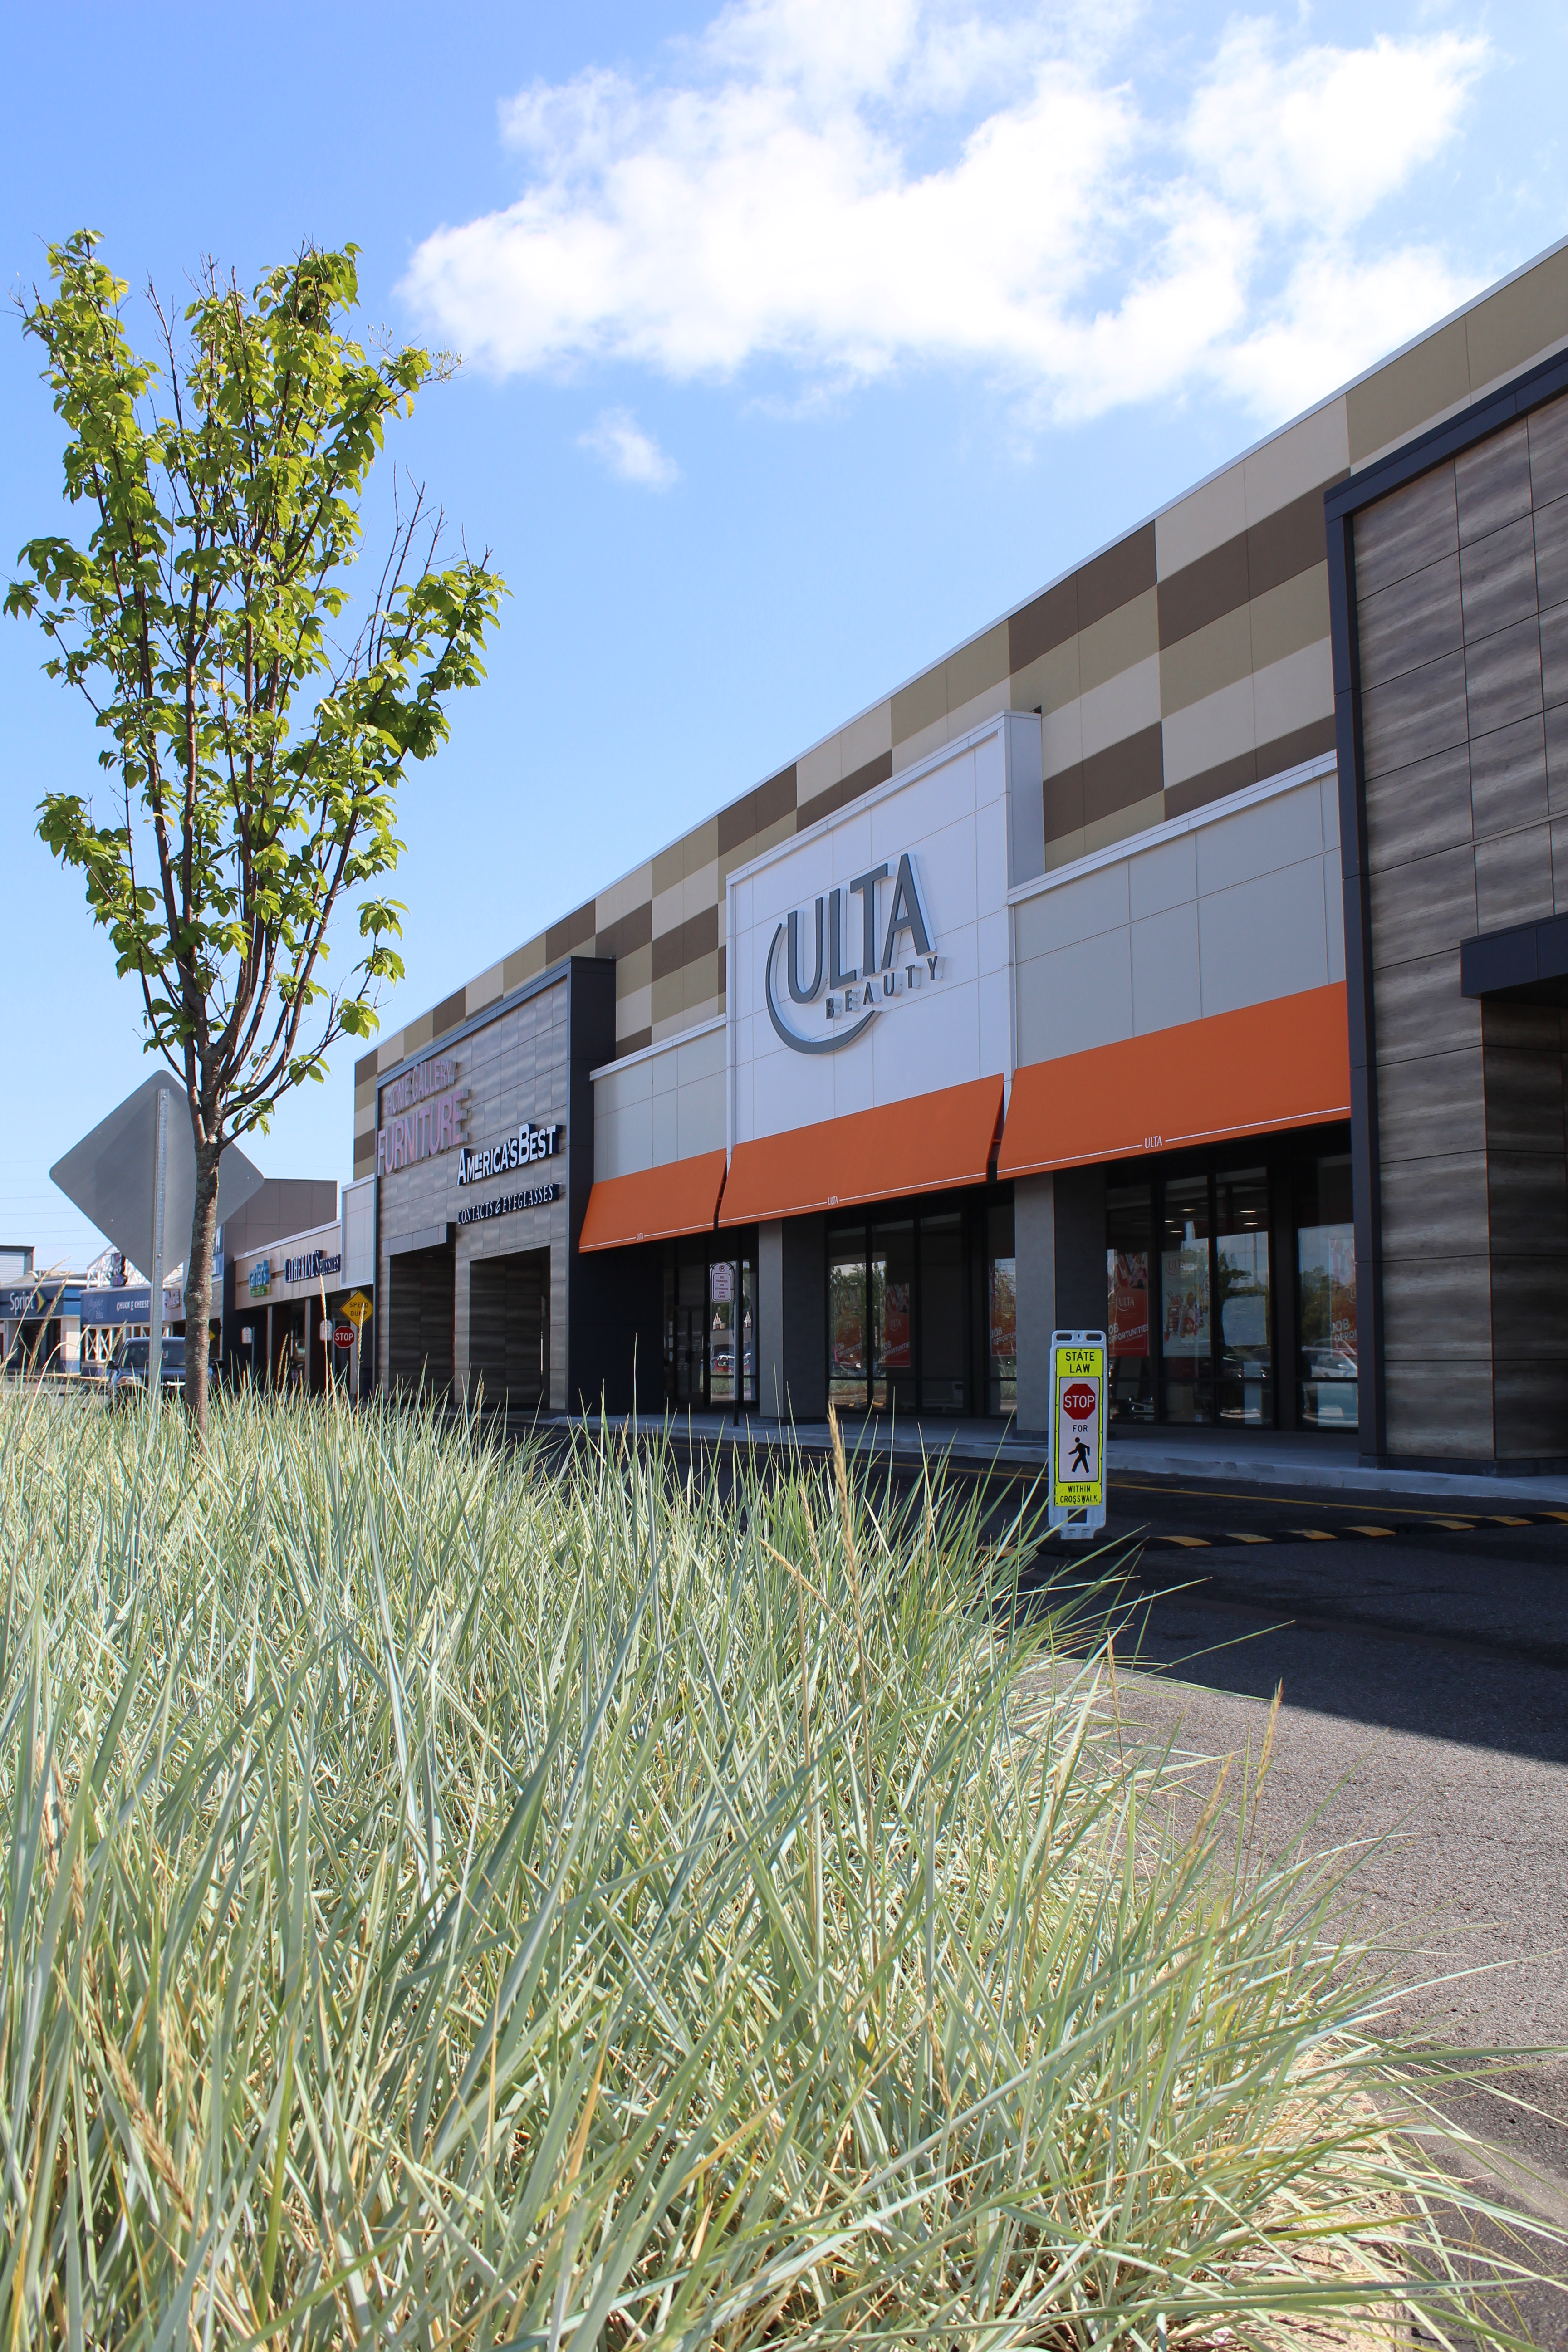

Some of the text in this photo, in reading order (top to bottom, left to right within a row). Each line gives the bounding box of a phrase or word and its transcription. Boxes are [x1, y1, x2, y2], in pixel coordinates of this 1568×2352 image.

[787, 853, 936, 1004] ULTA
[825, 956, 944, 1020] BEAUTY
[387, 1060, 455, 1116] HOME GALLERY
[377, 1089, 468, 1176] FURNITURE
[1145, 1135, 1162, 1149] ULTA
[457, 1123, 558, 1186] AMERICA'S BEST
[457, 1201, 493, 1225] CONTACTS
[502, 1183, 554, 1212] EYEGLASSES
[828, 1196, 838, 1205] ULTA
[10, 1291, 34, 1316] Sprint
[116, 1301, 130, 1312] CHUCK
[130, 1301, 134, 1311] E
[1118, 1297, 1135, 1306] ULTA
[991, 1326, 1002, 1338] JOB
[1108, 1323, 1119, 1335] OB
[1331, 1318, 1350, 1334] JOB
[335, 1333, 353, 1341] STOP
[1334, 1329, 1357, 1343] OPPO
[836, 1342, 844, 1352] JOB
[881, 1340, 891, 1352] JOB
[1065, 1352, 1095, 1361] STATE
[1069, 1364, 1090, 1373] LAW
[1064, 1395, 1095, 1408] STOP
[1060, 1495, 1098, 1503] CROSSWALK
